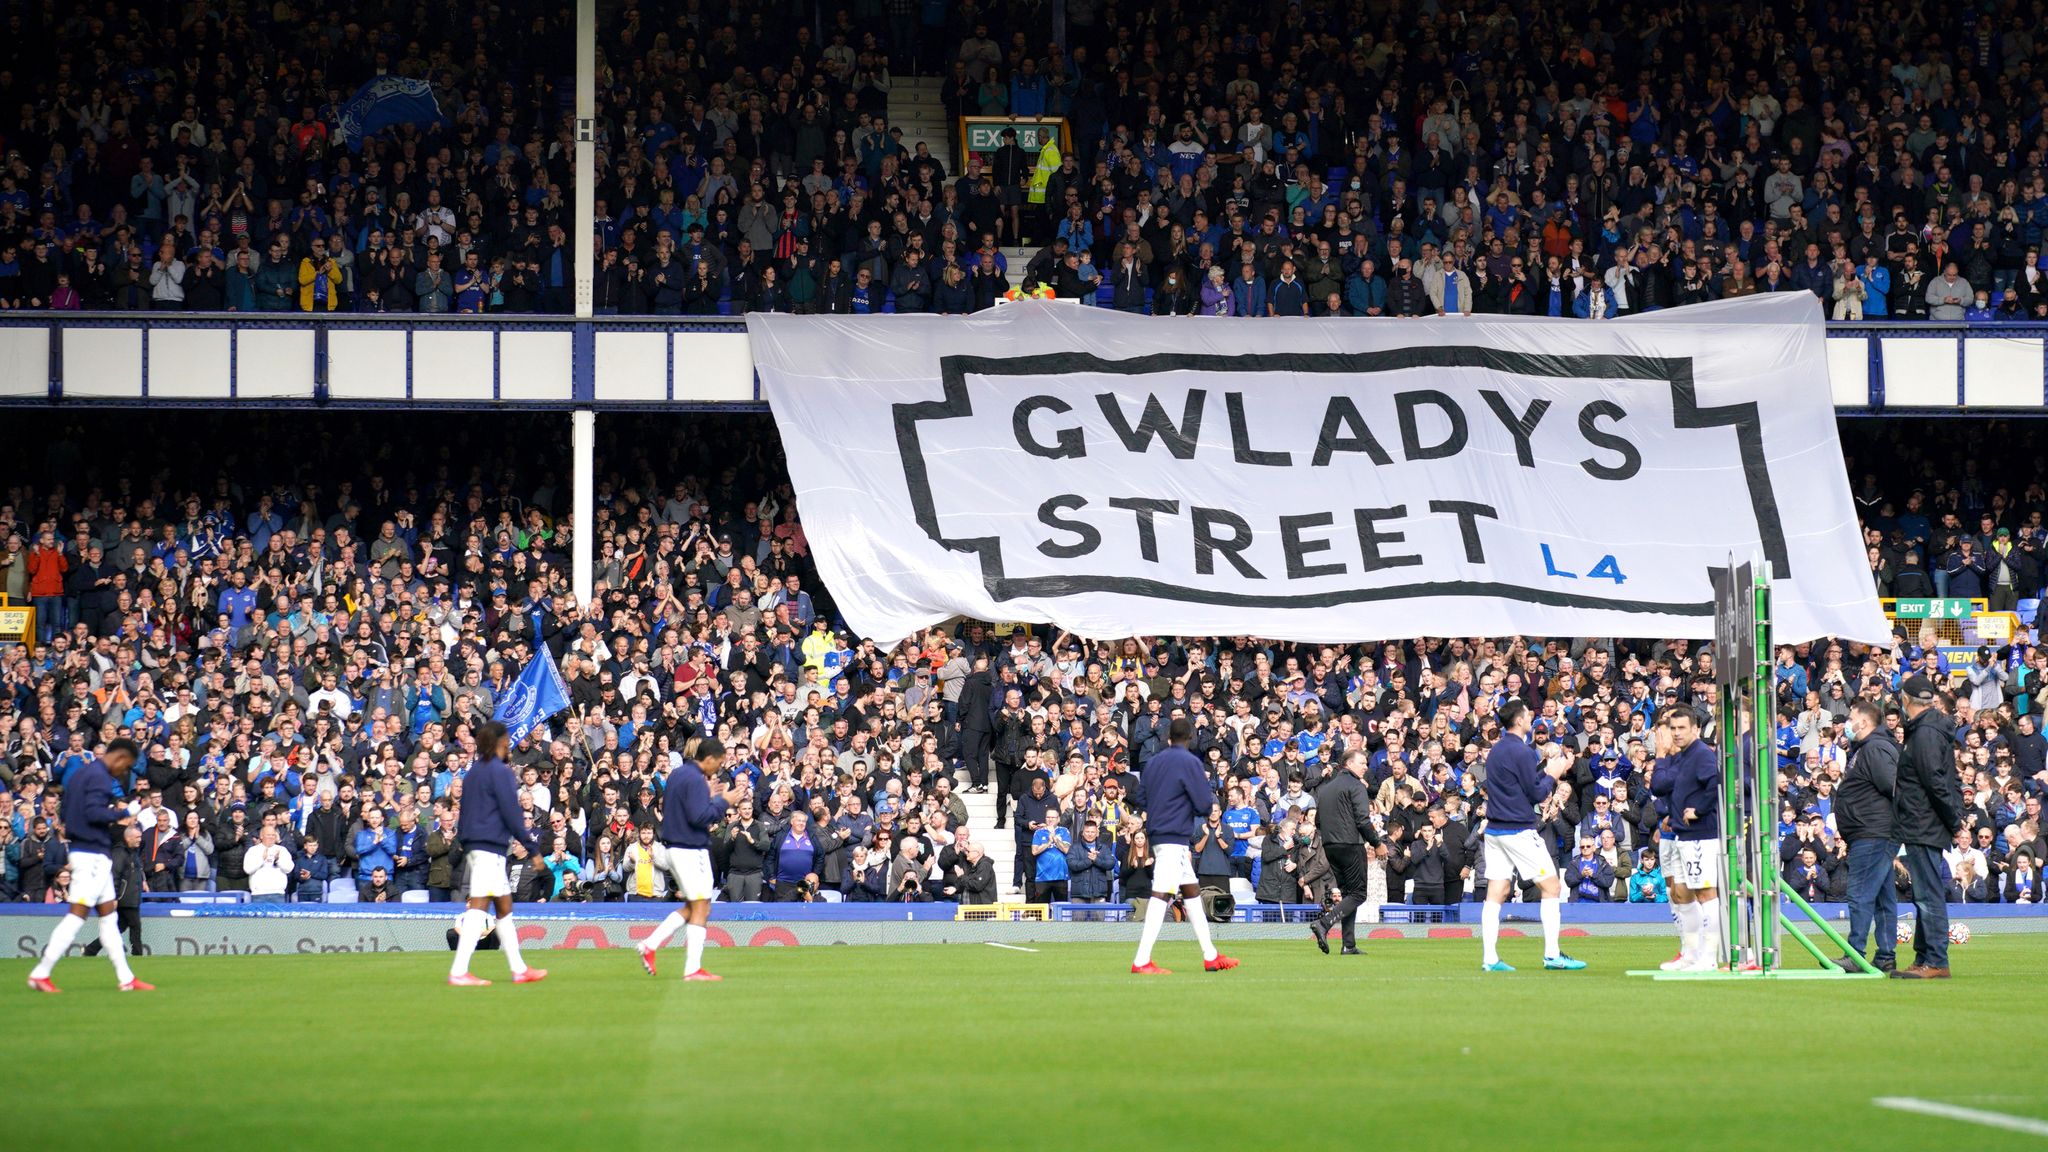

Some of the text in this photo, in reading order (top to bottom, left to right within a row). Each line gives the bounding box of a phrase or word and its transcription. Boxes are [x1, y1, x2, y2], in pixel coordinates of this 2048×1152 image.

[972, 128, 1020, 147] EX
[1018, 248, 1025, 256] G
[1012, 388, 1641, 481] GWLADYS
[1036, 492, 1627, 585] STREET L4
[1900, 603, 1925, 613] EXIT
[1686, 861, 1702, 876] 23
